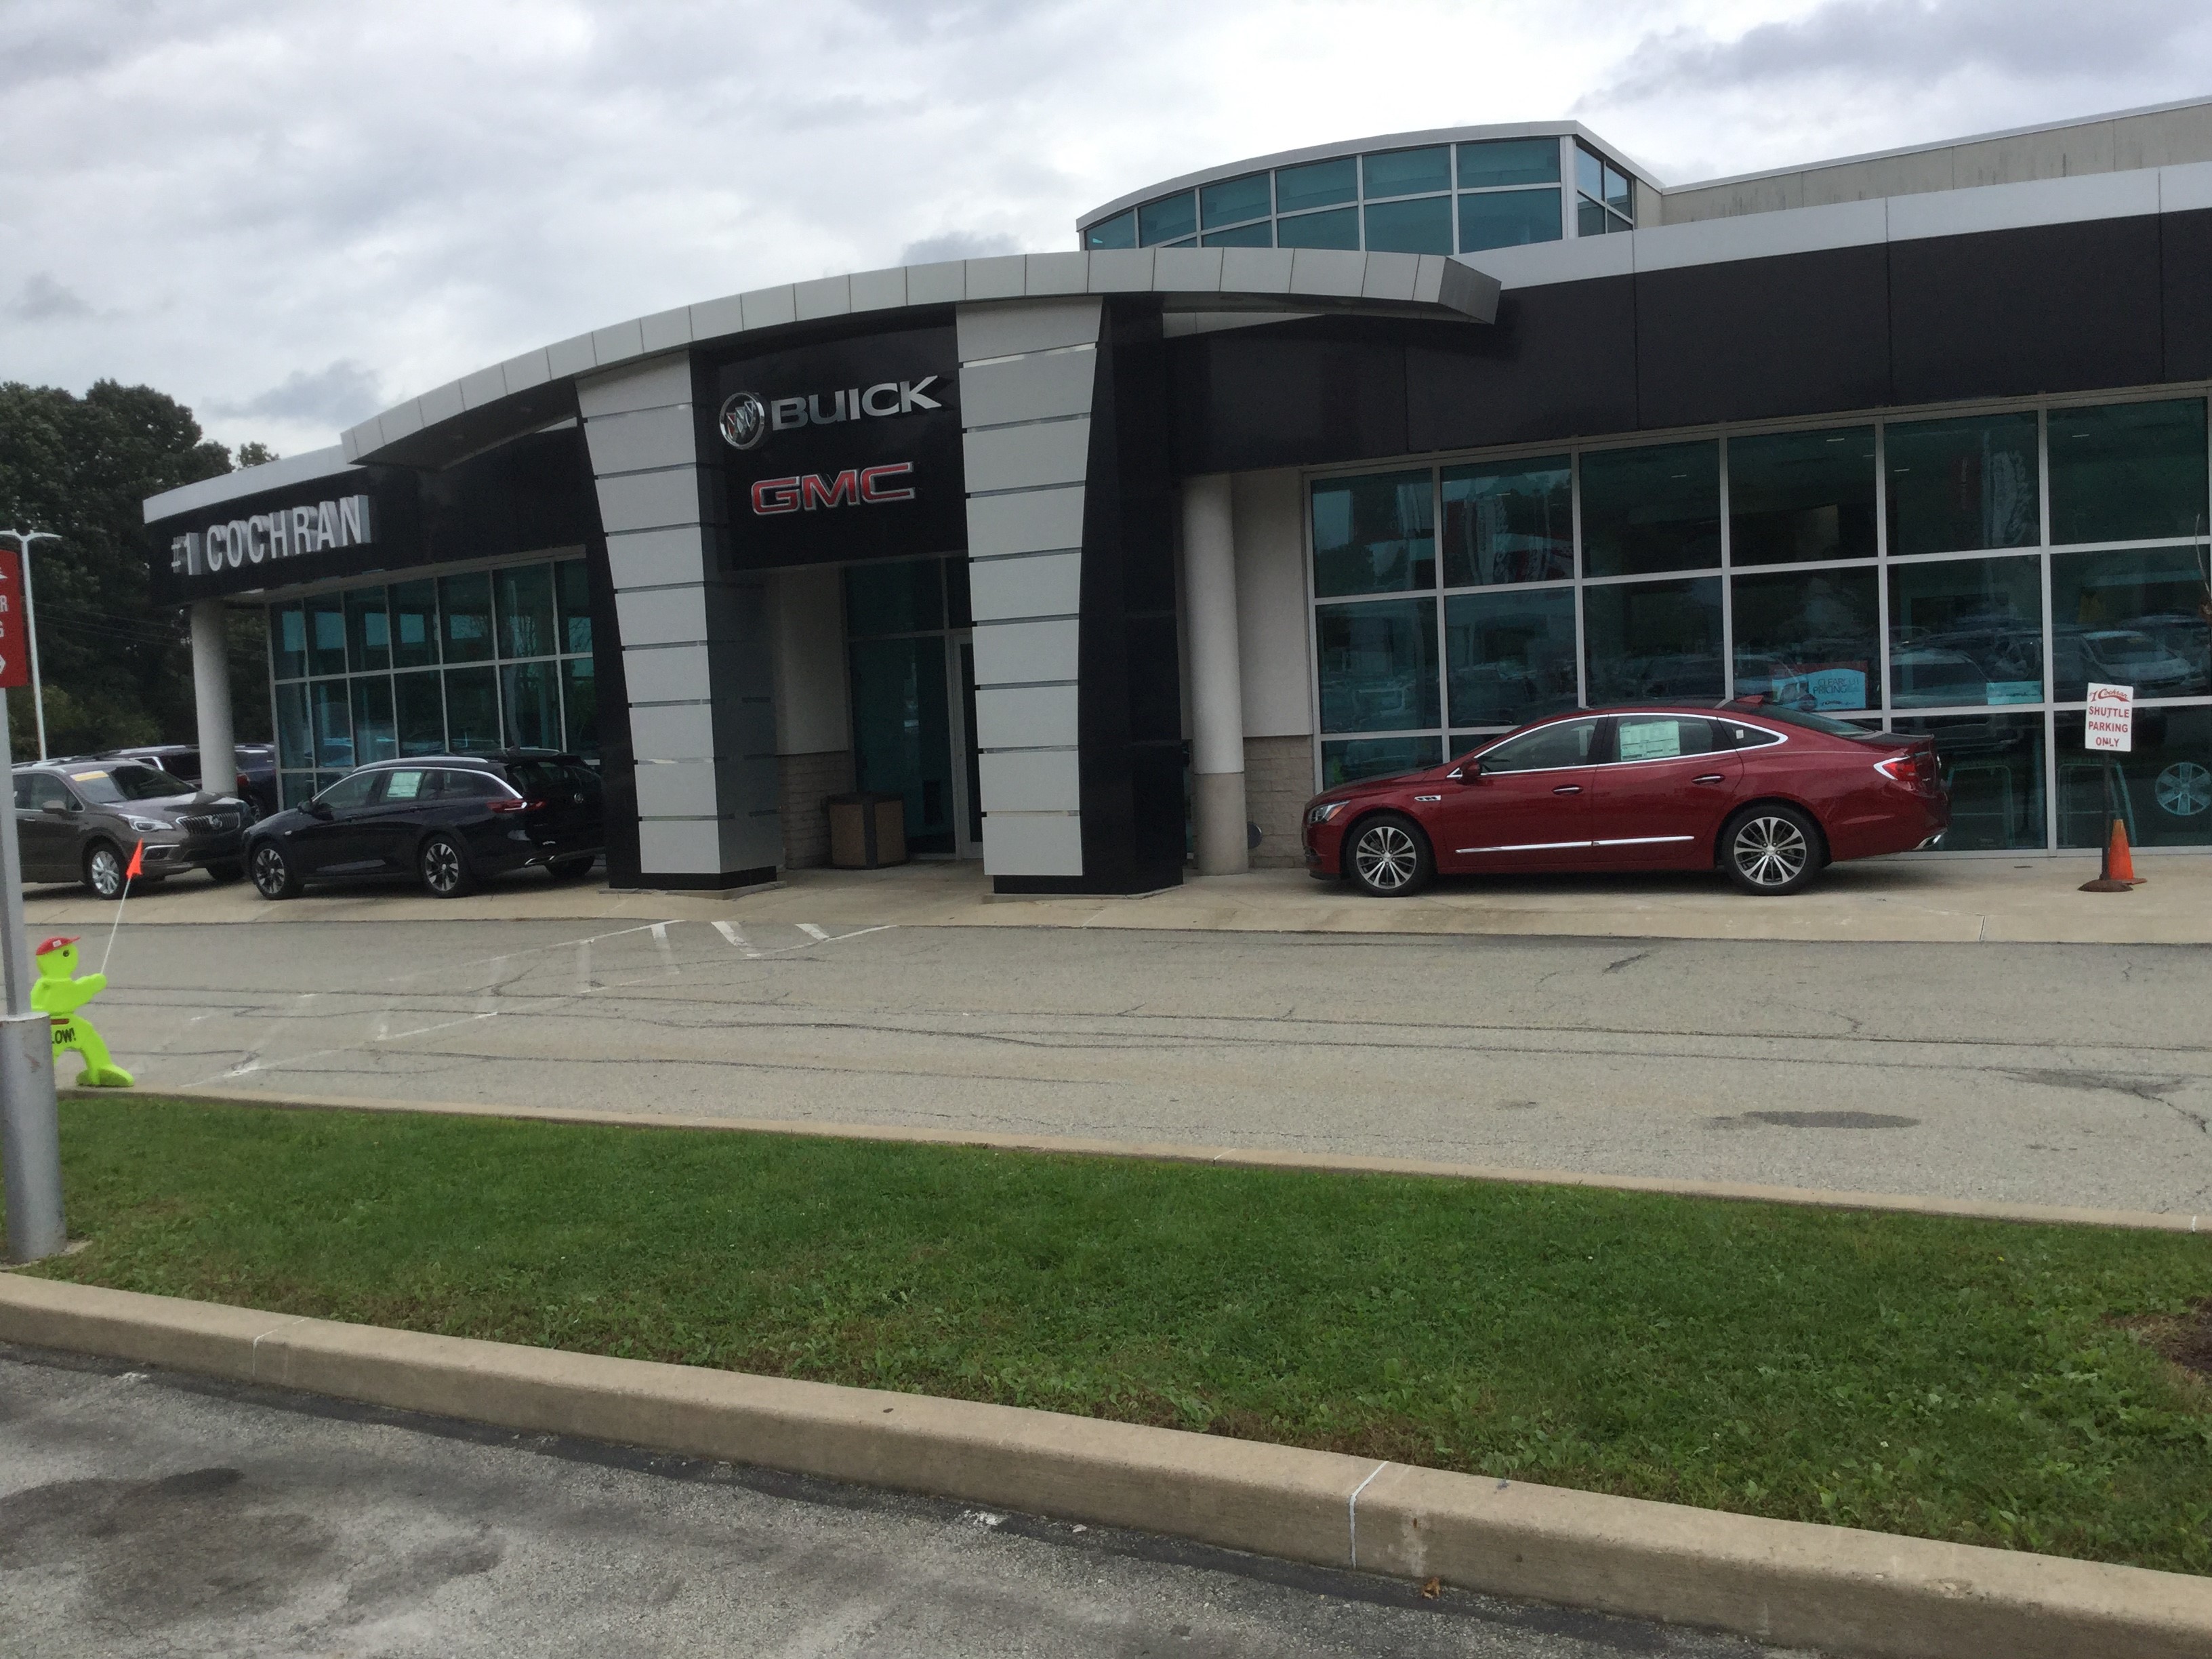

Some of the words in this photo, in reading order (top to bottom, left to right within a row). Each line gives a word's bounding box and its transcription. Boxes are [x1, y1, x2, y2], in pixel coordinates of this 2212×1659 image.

[771, 375, 942, 431] BUICK
[752, 462, 915, 515] GMC
[207, 495, 371, 571] COCHRAN
[2088, 721, 2128, 733] PARKING
[2089, 706, 2129, 718] SHUTTLE
[2095, 737, 2120, 747] ONLY
